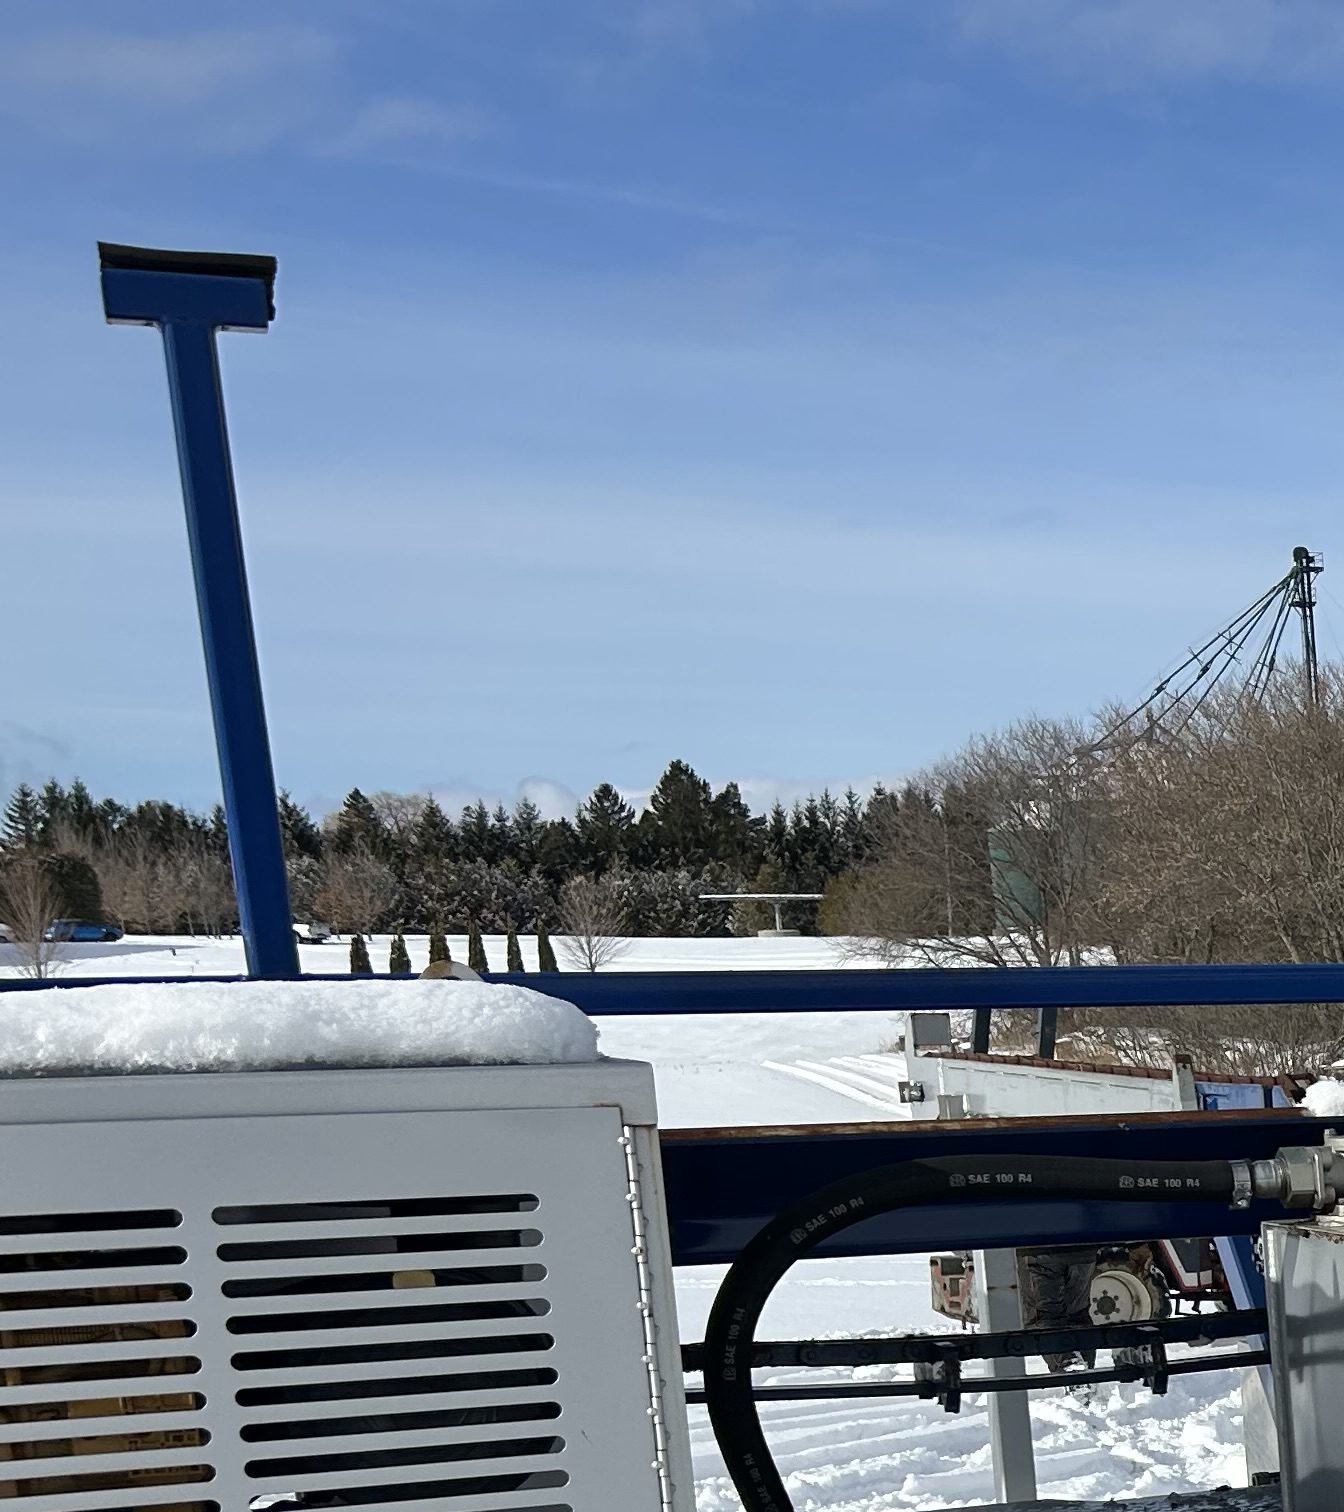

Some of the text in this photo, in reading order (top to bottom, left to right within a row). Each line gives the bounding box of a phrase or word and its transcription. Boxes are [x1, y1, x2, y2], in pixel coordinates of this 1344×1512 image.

[968, 1173, 1032, 1184] SAE 100 R4
[1137, 1177, 1200, 1188] SAE 100 R4
[805, 1196, 865, 1233] SAE 100 R4
